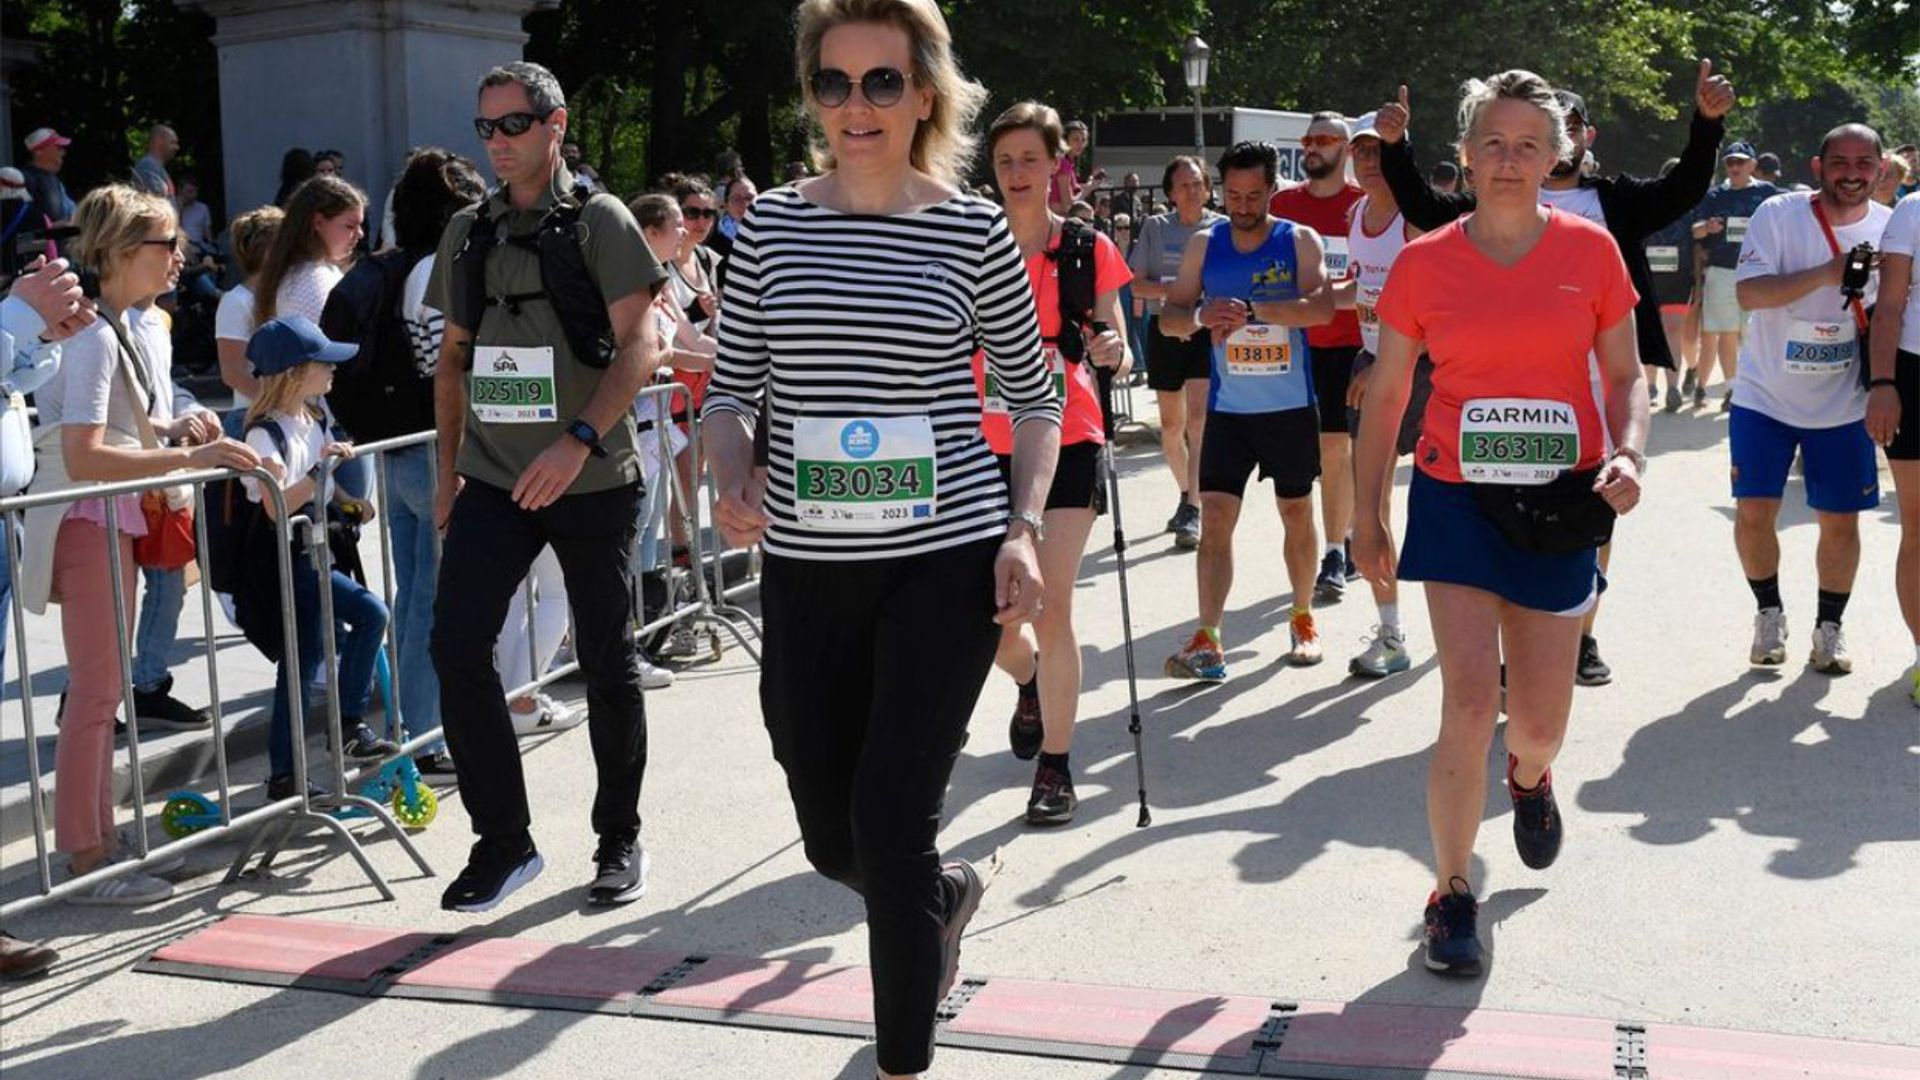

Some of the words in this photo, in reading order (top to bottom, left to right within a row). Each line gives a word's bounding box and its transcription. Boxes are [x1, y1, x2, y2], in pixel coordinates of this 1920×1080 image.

[1233, 347, 1284, 361] 13813
[493, 360, 519, 372] SPA
[478, 381, 542, 401] 32519
[1466, 407, 1569, 424] GARMIN
[1474, 435, 1566, 460] 36312
[808, 465, 921, 498] 33034
[881, 507, 909, 520] 2023
